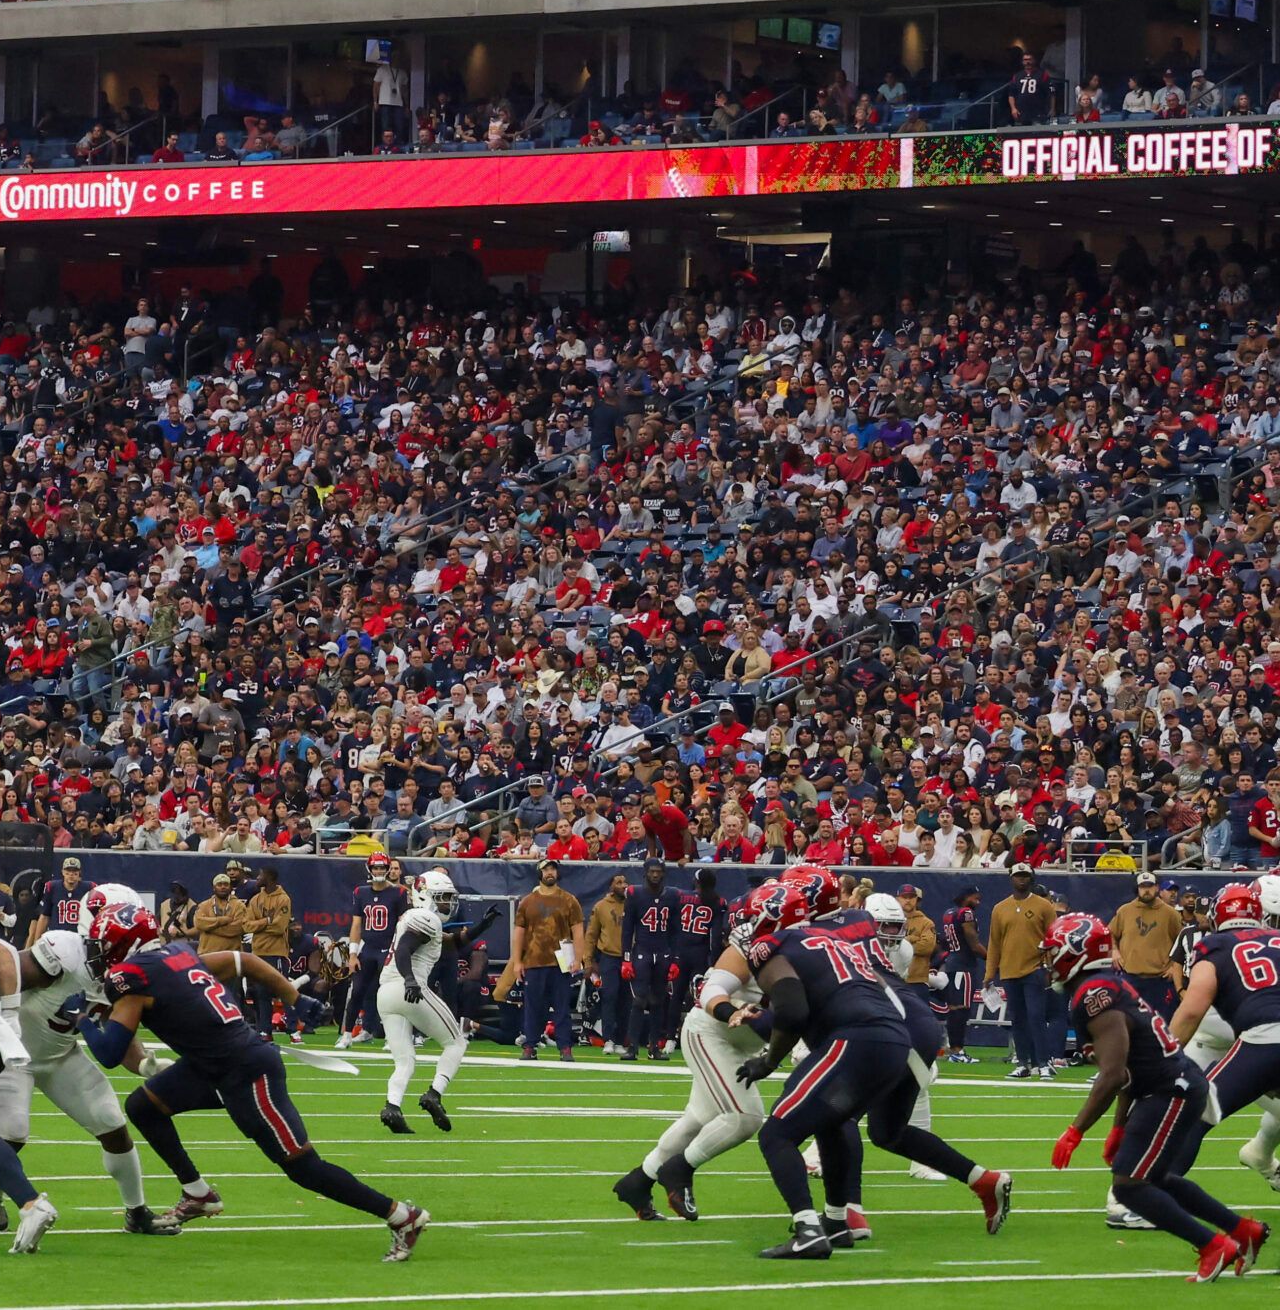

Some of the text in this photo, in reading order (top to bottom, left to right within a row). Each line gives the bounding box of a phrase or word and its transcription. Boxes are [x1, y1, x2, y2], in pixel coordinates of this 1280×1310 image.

[1019, 78, 1036, 94] 78
[1002, 136, 1119, 177] OFFICIAL
[1126, 131, 1228, 173] COFFEE
[1236, 128, 1272, 168] OF
[0, 173, 264, 218] Community COFFEE
[181, 306, 188, 320] 7
[293, 416, 304, 427] 23
[1052, 528, 1068, 540] 24
[530, 751, 537, 760] 7
[57, 900, 82, 924] 18
[363, 904, 389, 931] 10
[641, 906, 669, 932] 41
[680, 904, 713, 934] 42
[188, 969, 244, 1024] 2
[1083, 987, 1113, 1017] 26
